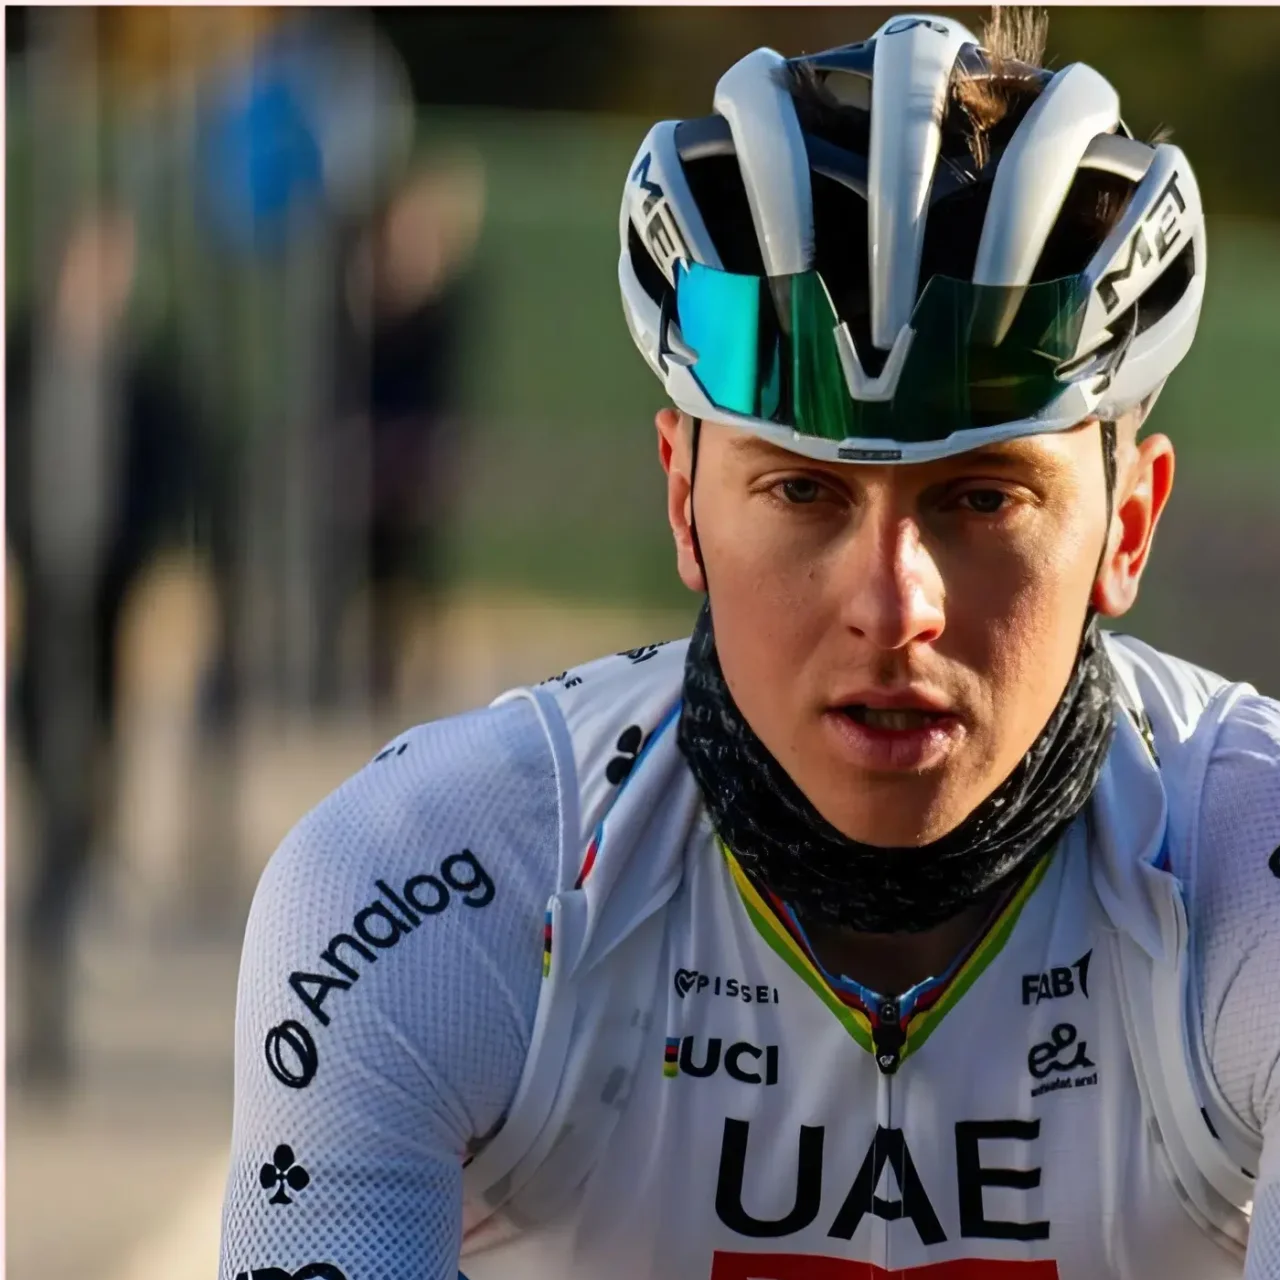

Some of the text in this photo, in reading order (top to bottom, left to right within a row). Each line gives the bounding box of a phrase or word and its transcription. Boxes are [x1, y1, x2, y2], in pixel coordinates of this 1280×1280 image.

[1096, 170, 1186, 315] MET
[288, 848, 495, 1026] Analog
[696, 975, 779, 1004] PISSEI
[679, 1035, 779, 1086] UCI
[714, 1116, 1051, 1246] UAE
